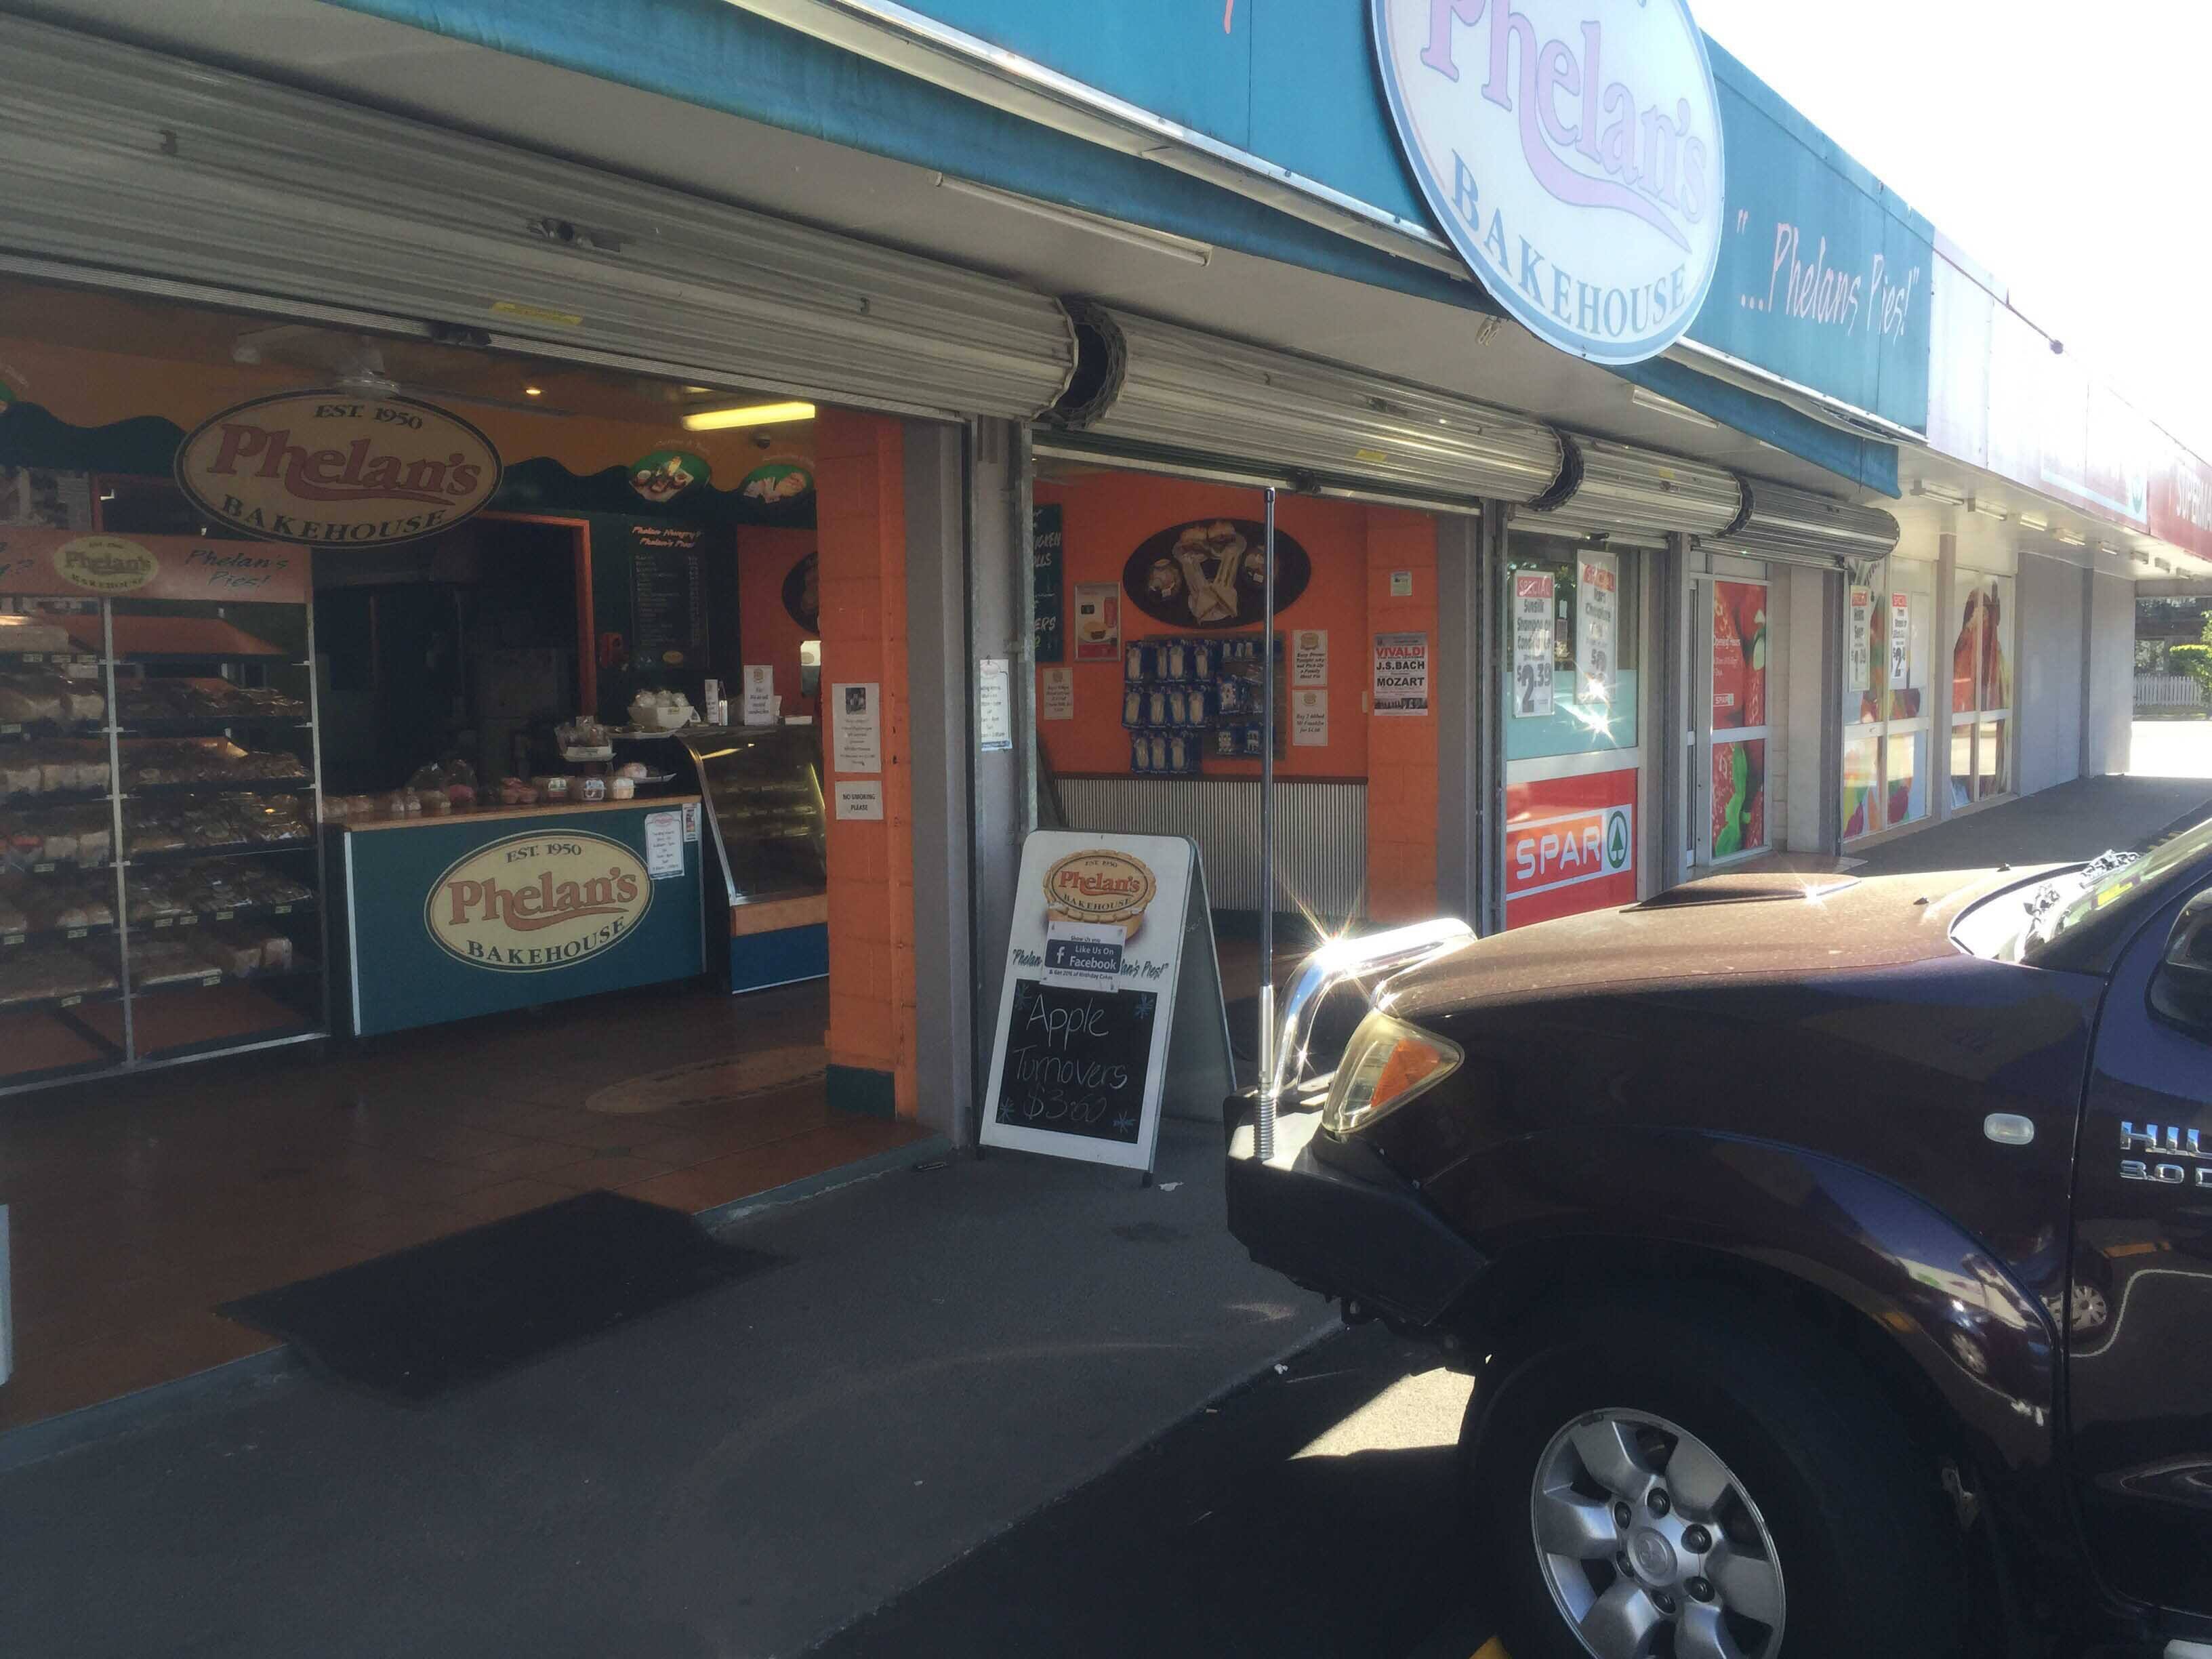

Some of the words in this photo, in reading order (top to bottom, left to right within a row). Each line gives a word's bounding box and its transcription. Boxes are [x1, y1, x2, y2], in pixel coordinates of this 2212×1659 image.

[1420, 0, 1708, 253] Phelan's
[1451, 148, 1687, 338] BAKEHOUSE
[373, 405, 424, 430] 1950
[206, 424, 481, 506] Phelan's
[221, 493, 449, 541] BAKEHOUSE
[185, 549, 289, 570] Phelan's
[1376, 646, 1425, 657] VIVALDI
[1376, 677, 1425, 687] MOZART
[507, 847, 539, 863] EST.
[547, 843, 582, 856] 1950
[1516, 825, 1601, 880] SPAR
[447, 867, 638, 931] Phelan's
[1058, 871, 1141, 896] Phelan's
[1062, 894, 1132, 910] BAKEHOUSE
[467, 916, 625, 964] BAKEHOUSE
[1076, 945, 1090, 954] Like
[1092, 946, 1101, 955] Us
[1103, 946, 1114, 956] On
[1069, 956, 1117, 970] Facebook
[1026, 994, 1109, 1049] Apple
[1013, 1045, 1128, 1090] Turnovers
